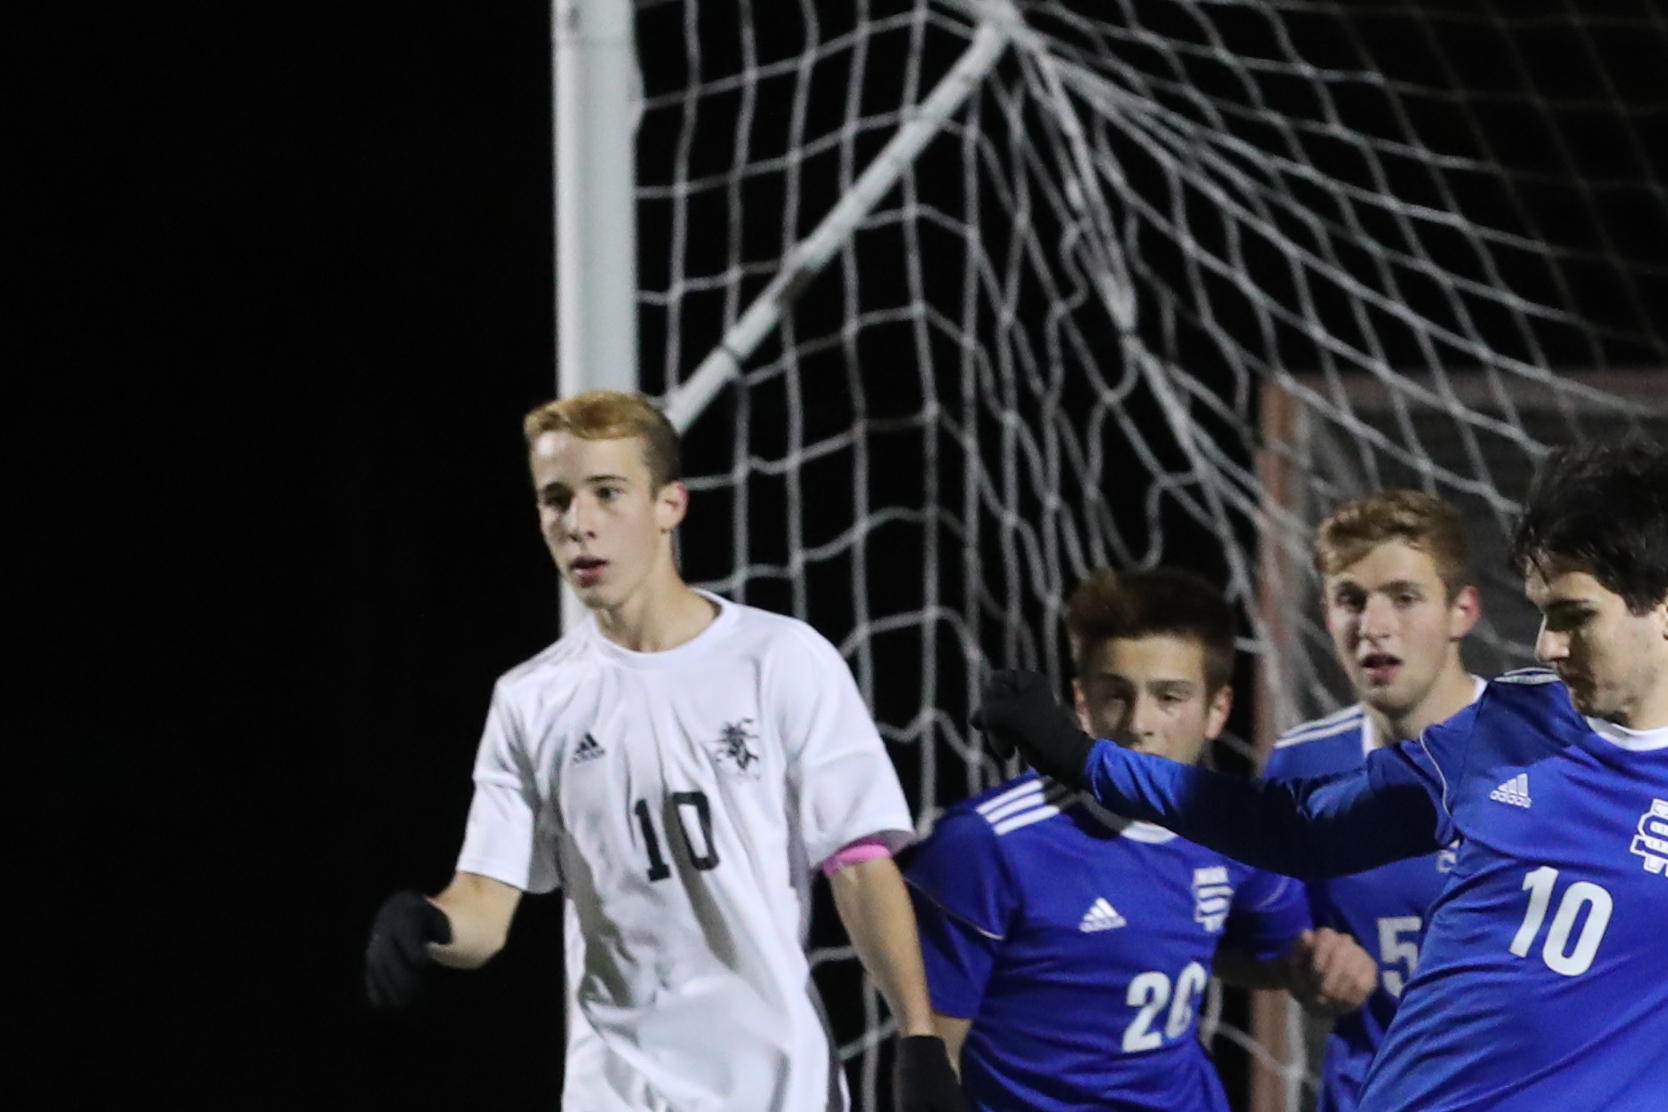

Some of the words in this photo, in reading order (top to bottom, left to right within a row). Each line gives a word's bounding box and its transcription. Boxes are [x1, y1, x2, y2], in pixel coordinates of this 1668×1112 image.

[634, 791, 720, 882] 10
[1377, 915, 1423, 998] 5
[1508, 865, 1614, 977] 10
